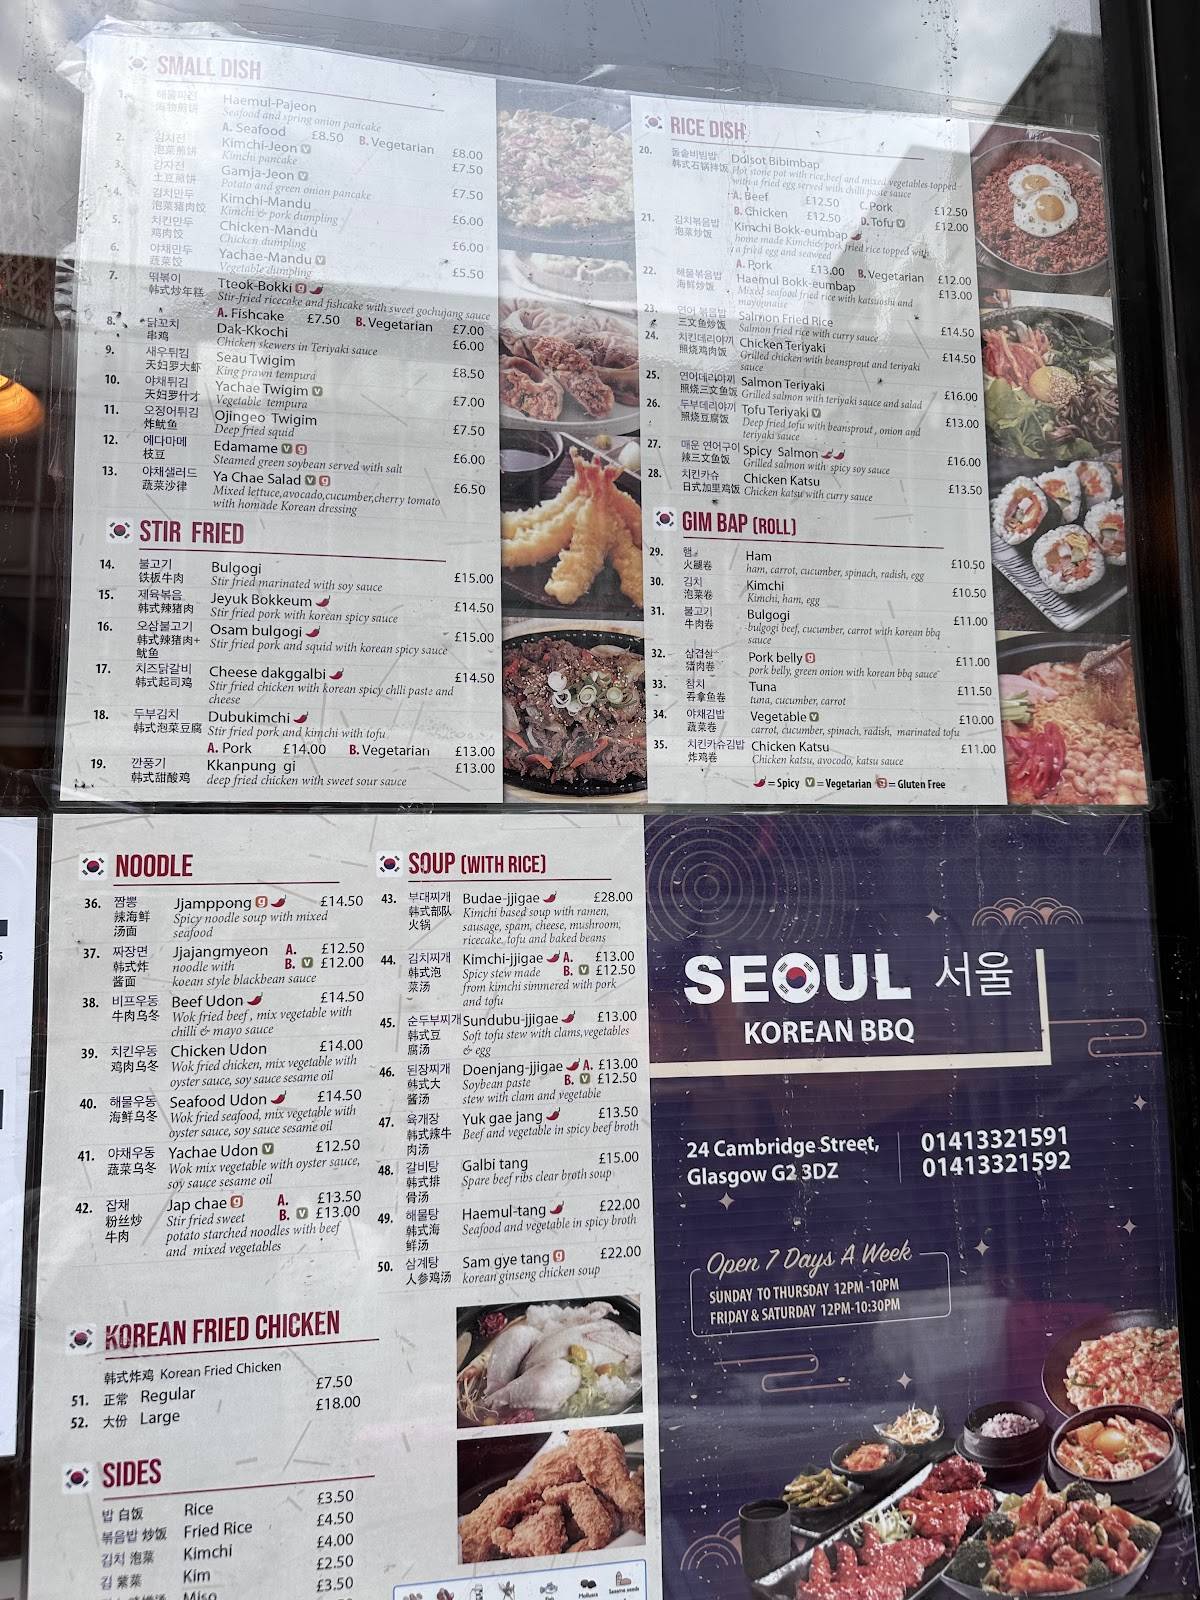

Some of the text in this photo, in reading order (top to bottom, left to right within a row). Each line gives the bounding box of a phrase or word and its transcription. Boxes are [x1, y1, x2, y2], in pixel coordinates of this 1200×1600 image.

[157, 55, 261, 80] SMALL DISH
[670, 116, 747, 140] RICE DISH
[222, 137, 297, 155] Kimchi-Jeon
[452, 163, 483, 175] £7.50
[871, 217, 894, 228] Tofu
[936, 222, 969, 232] £12.00
[109, 270, 118, 280] 7.
[217, 278, 292, 294] Tteok-Bokki
[217, 307, 284, 321] A. Fishcake
[307, 314, 340, 325] £7.50
[217, 323, 288, 338] Dak-Kkochi
[356, 317, 433, 332] B. Vegetarian
[453, 324, 484, 336] £7.00
[645, 330, 659, 340] 24.
[453, 340, 484, 352] £6.00
[740, 338, 826, 354] Chicken Teriyaki
[217, 351, 295, 368] Seau Twigim
[942, 353, 976, 364] £14.50
[453, 368, 485, 379] £8.50
[741, 376, 825, 392] Salmon Teriyaki
[944, 391, 978, 402] £16.00
[143, 435, 187, 447] 에다마메
[214, 440, 278, 454] Edamame
[453, 453, 485, 465] £6.00
[743, 445, 818, 459] Spicy Salmon
[213, 454, 402, 473] Steamed green soybean served with salt
[947, 456, 981, 467] £16.00
[743, 473, 820, 486] Chicken Katsu
[948, 484, 982, 495] £13.50
[682, 511, 712, 532] GIM
[717, 512, 748, 533] BAP
[140, 520, 244, 544] STIR FRIED
[746, 551, 772, 562] Ham
[100, 559, 114, 569] 14.
[139, 558, 172, 570] 불고기
[212, 561, 261, 577] Bulgogi
[951, 559, 985, 570] £10.50
[454, 572, 494, 584] £15.00
[747, 580, 784, 591] Kimchi
[210, 593, 312, 607] Jeyuk Bokkeum
[138, 602, 194, 614] 韩式辣猪肉
[454, 602, 494, 613] £14.50
[209, 665, 326, 682] Cheese dakggalbi
[455, 672, 495, 683] £14.50
[749, 681, 776, 692] Tuna
[957, 686, 992, 696] £11.50
[750, 695, 846, 706] tuna, cucumber, carrot
[686, 709, 725, 720] 야채김밥
[750, 711, 807, 724] Vegetable
[959, 715, 994, 725] £10.00
[207, 759, 296, 774] Kkanpung gi
[456, 763, 495, 774] £13.00
[777, 778, 800, 790] Spicy
[825, 778, 872, 791] Vegetarian
[897, 779, 946, 789] Gluten Free
[116, 854, 193, 877] NOODLE
[409, 852, 455, 874] SOUP
[320, 895, 363, 907] £14.50
[381, 894, 396, 904] 43.
[463, 892, 540, 907] Budae-jjigae
[594, 891, 633, 902] £28.00
[174, 898, 251, 913] Jjamppong
[173, 910, 328, 927] Spicy noodle soup with mixed
[173, 926, 213, 940] seafood
[684, 953, 911, 1004] SEOUL
[935, 952, 1013, 996] 서울
[172, 994, 243, 1008] Beef Udon
[321, 990, 364, 1003] £14.50
[112, 1009, 159, 1022] 牛肉乌冬
[745, 1018, 914, 1045] KOREAN BBQ
[170, 1093, 267, 1109] Seafood Udon
[921, 1126, 1067, 1152] 01413321591
[687, 1136, 879, 1158] 24 Cambridge Street,
[599, 1151, 639, 1164] £15.00
[923, 1151, 1071, 1177] 01413321592
[462, 1158, 528, 1172] Galbi tang
[687, 1162, 839, 1188] Glasgow G2 3DZ
[600, 1198, 640, 1212] £22.00
[462, 1204, 546, 1223] Haemul-tang
[707, 1239, 912, 1280] Open 7 Days A Week
[406, 1271, 451, 1285] 人参鸡汤
[709, 1287, 752, 1304] SUNDAY
[757, 1287, 771, 1300] TO
[773, 1283, 829, 1299] THURSDAY
[711, 1309, 749, 1326] FRIDAY
[751, 1309, 759, 1321] &
[762, 1304, 816, 1321] SATURDAY
[105, 1310, 339, 1350] KOREAN FRIED CHICKEN
[316, 1375, 352, 1389] £7.50
[72, 1395, 89, 1407] 51.
[104, 1393, 128, 1406] 正常
[141, 1386, 196, 1405] Regular
[316, 1395, 361, 1411] £18.00
[71, 1417, 88, 1429] 52.
[103, 1414, 127, 1429] 大份
[140, 1412, 180, 1426] Large
[103, 1459, 161, 1488] SIDES
[317, 1490, 354, 1504] £3.50
[185, 1503, 213, 1516] Rice
[317, 1511, 354, 1527] £4.50
[184, 1521, 252, 1538] Fried Rice
[317, 1533, 354, 1548] £4.00
[184, 1544, 232, 1561] Kimchi
[183, 1569, 210, 1583] Kim
